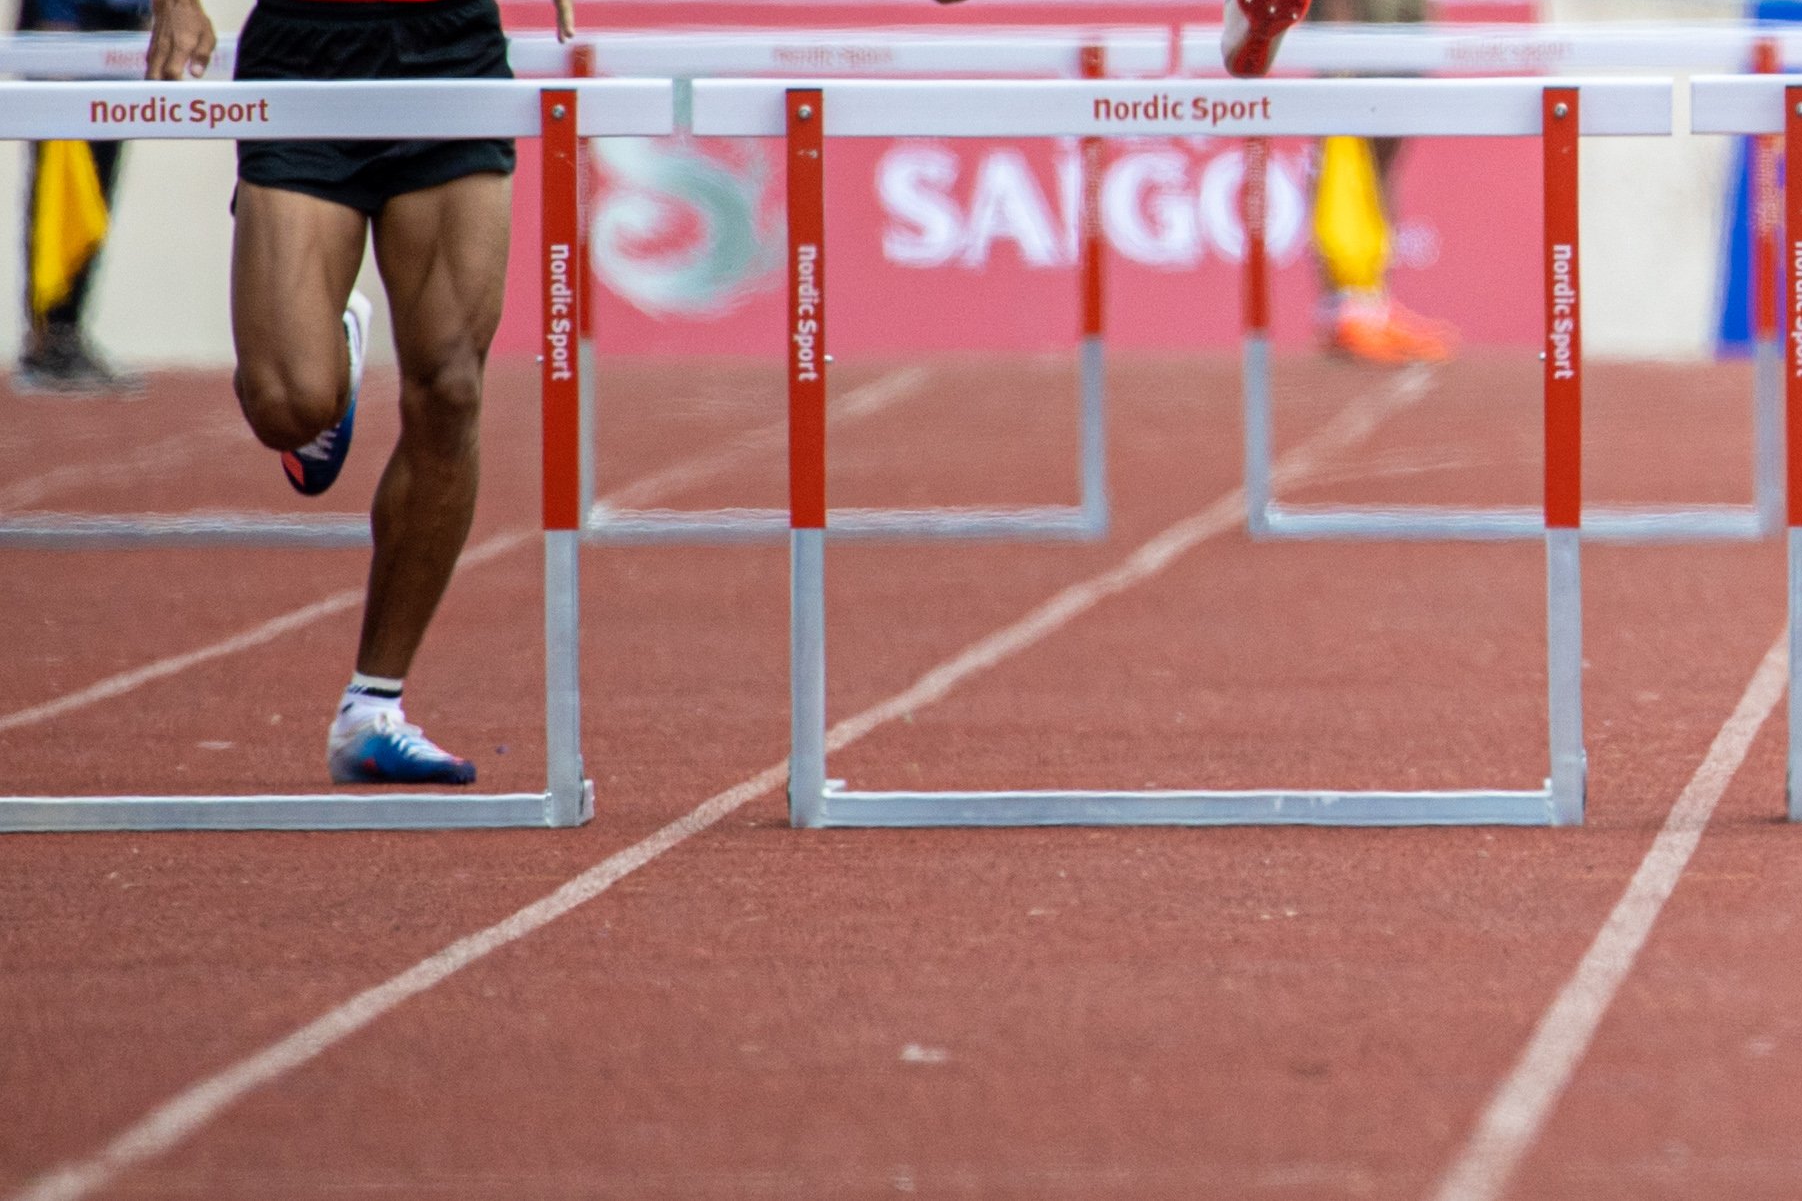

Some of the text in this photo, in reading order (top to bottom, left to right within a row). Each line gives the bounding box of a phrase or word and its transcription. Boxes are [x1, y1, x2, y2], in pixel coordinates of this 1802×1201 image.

[188, 98, 269, 129] Sport
[1191, 96, 1272, 127] Sport
[873, 142, 1318, 271] SAIGO
[546, 318, 573, 381] Sport
[792, 318, 819, 382] Sport
[1549, 317, 1575, 380] Sport
